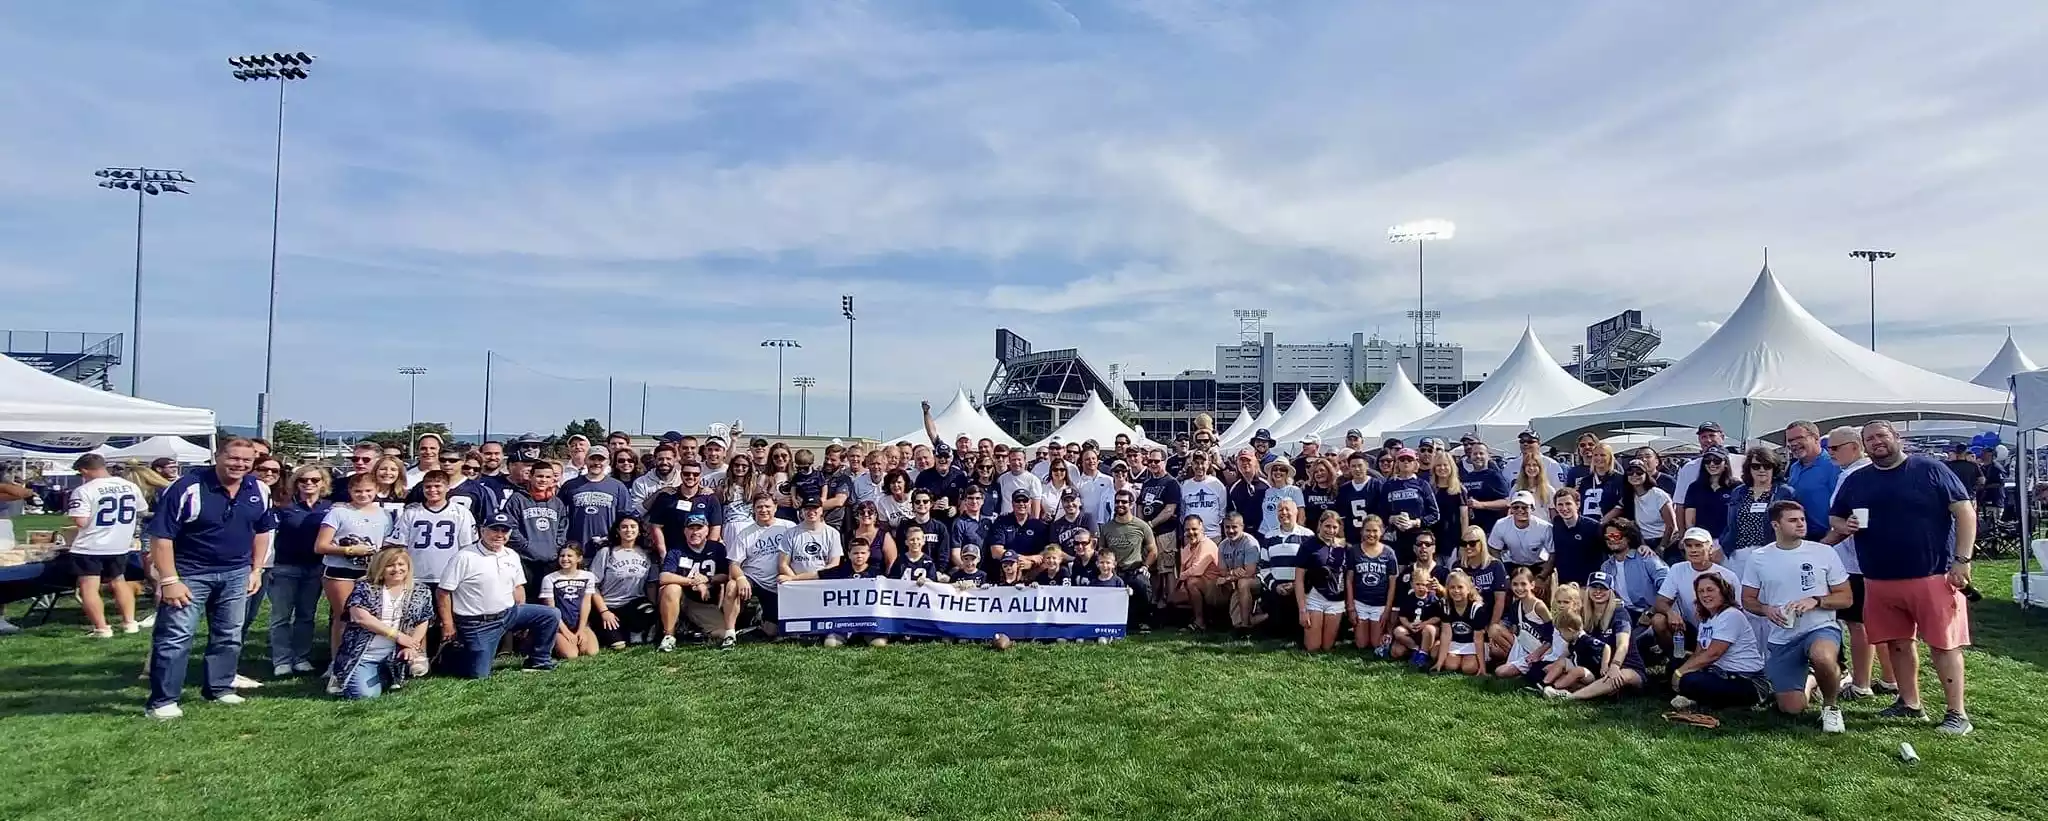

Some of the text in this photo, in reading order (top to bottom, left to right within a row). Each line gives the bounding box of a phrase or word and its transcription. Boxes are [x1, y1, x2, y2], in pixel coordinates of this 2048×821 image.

[97, 485, 132, 495] BARKLEY
[96, 494, 136, 526] 26
[1351, 500, 1367, 527] 5
[413, 520, 456, 550] 33
[823, 589, 1089, 614] PHI DELTA THETA ALUMNI
